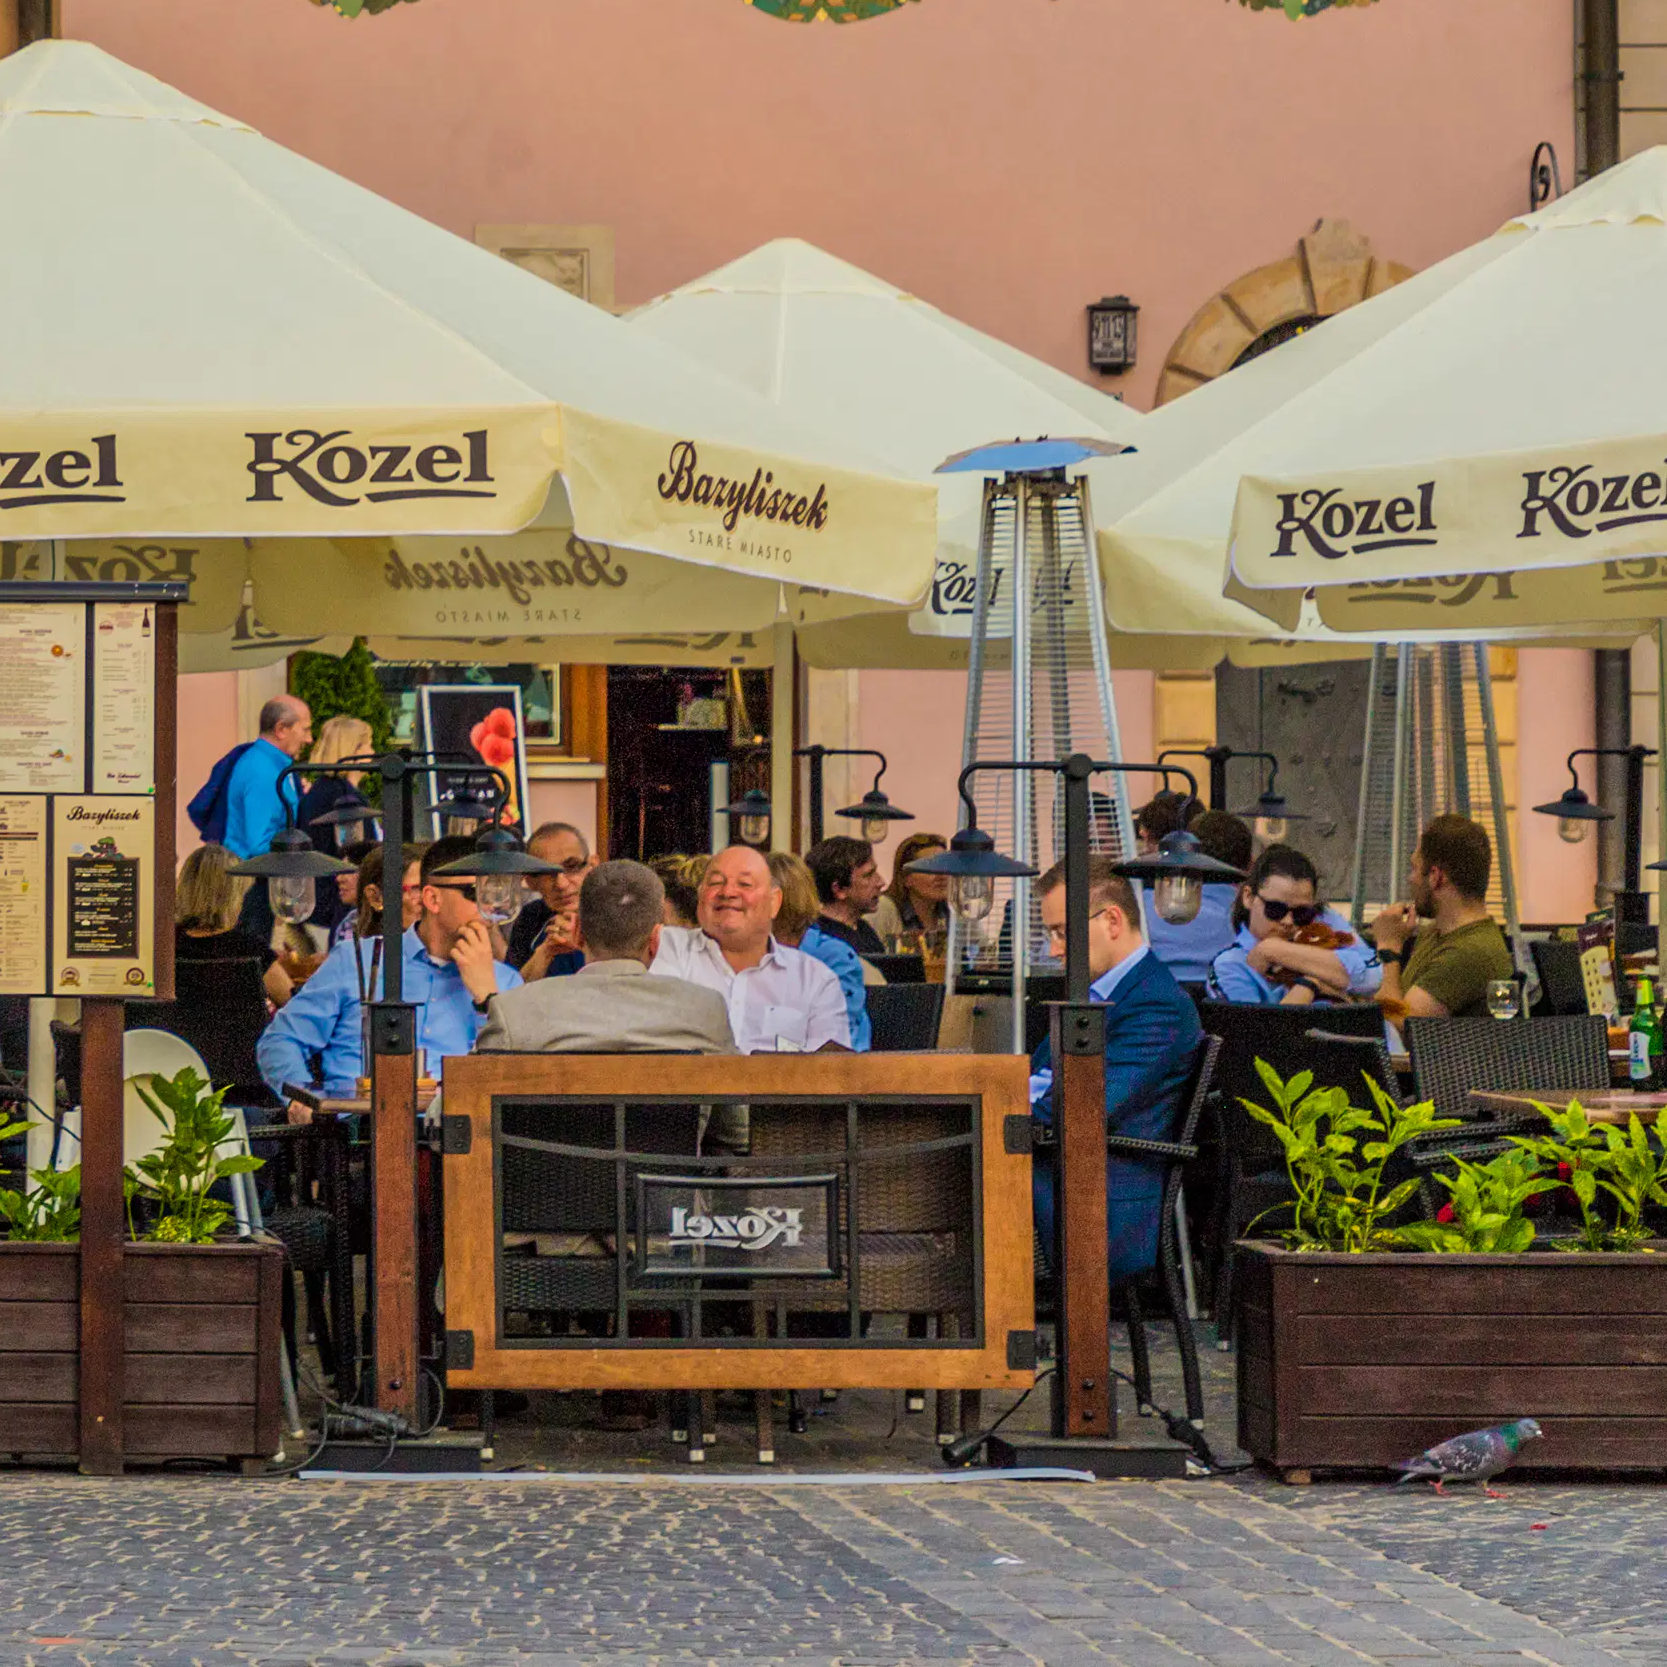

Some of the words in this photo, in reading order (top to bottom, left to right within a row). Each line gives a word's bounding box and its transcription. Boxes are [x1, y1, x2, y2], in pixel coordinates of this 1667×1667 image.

[245, 428, 496, 507] Kozel
[657, 439, 829, 533] Bazyliszek
[1516, 459, 1667, 539] Koze
[689, 531, 733, 551] STARE
[740, 540, 793, 564] MIASTO
[1269, 481, 1438, 560] Kozel
[66, 805, 141, 825] Bazyliszek
